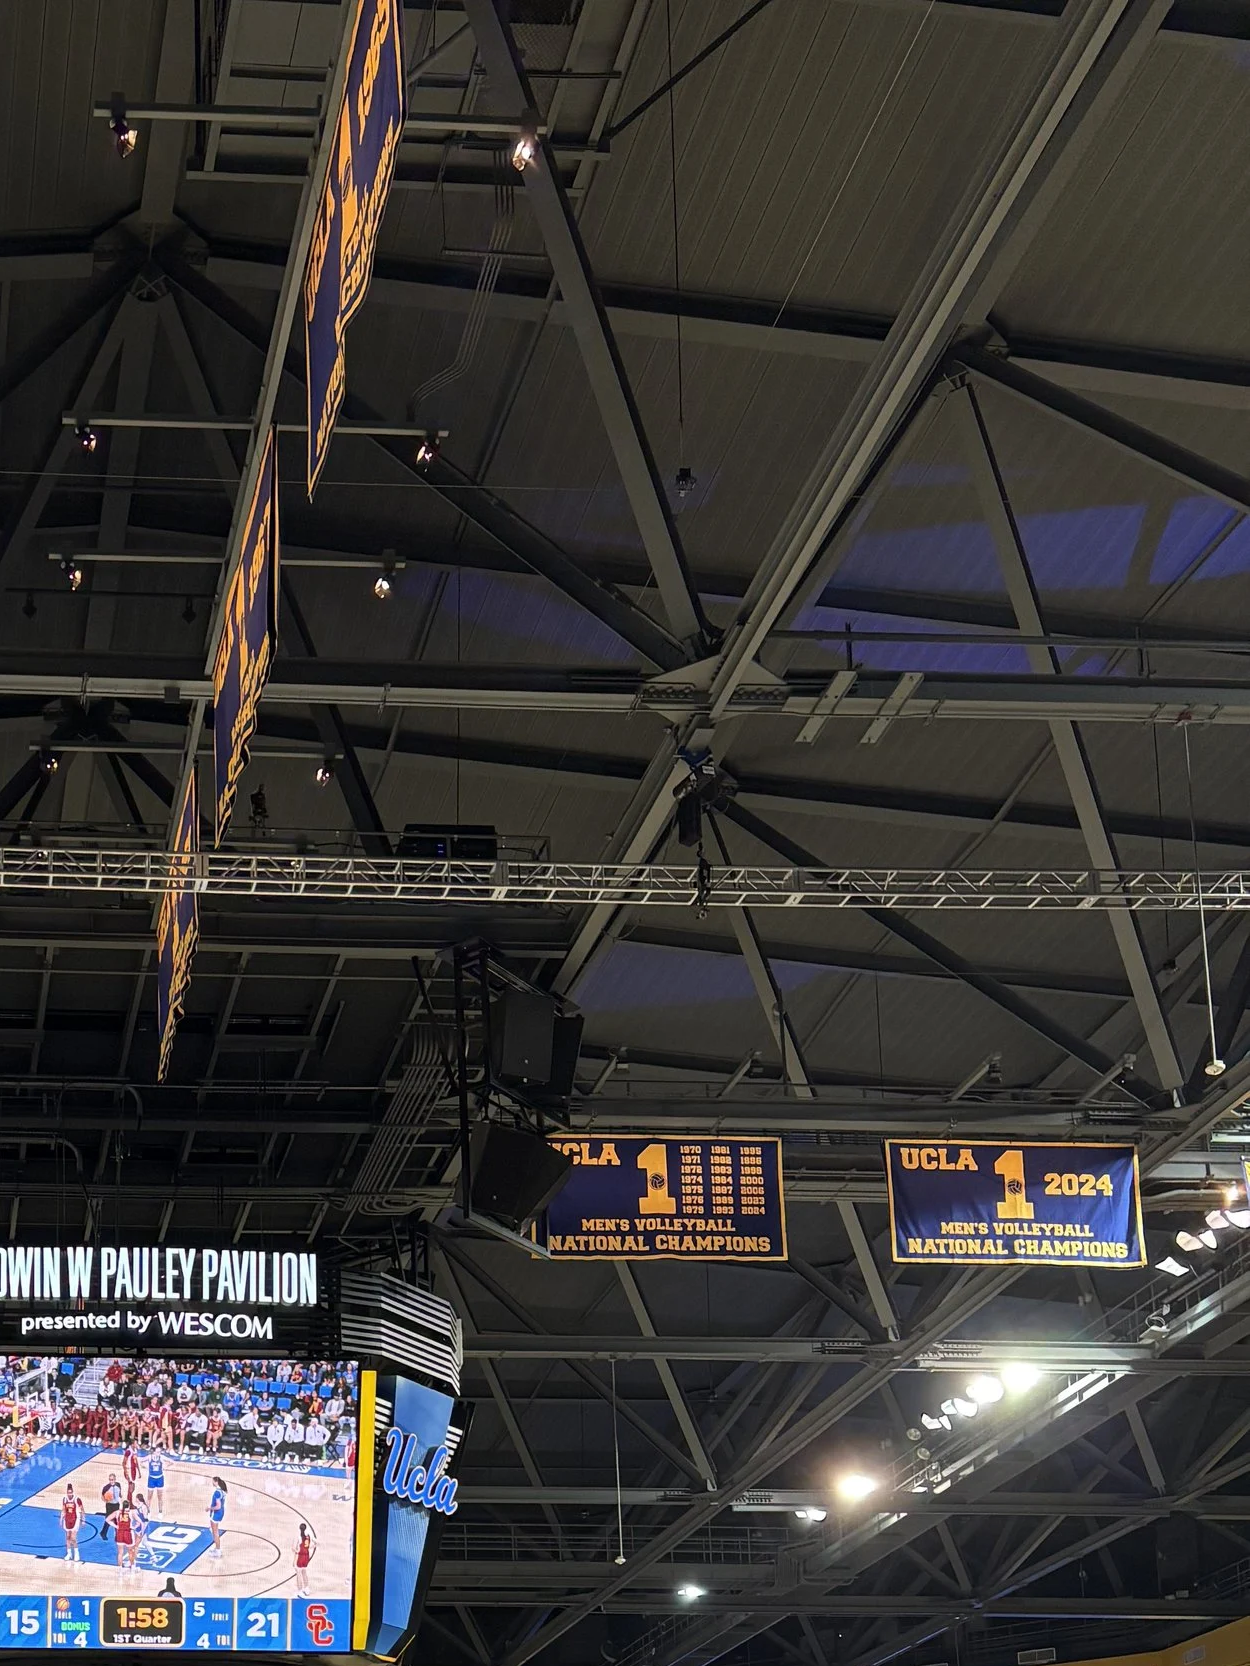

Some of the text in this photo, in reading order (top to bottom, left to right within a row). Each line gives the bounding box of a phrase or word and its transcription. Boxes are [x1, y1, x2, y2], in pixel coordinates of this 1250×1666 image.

[680, 1145, 702, 1154] 1970
[681, 1155, 701, 1164] 1971
[900, 1148, 978, 1171] UCLA
[681, 1165, 703, 1174] 1972
[637, 1143, 676, 1215] 1
[681, 1175, 703, 1184] 1974
[740, 1176, 764, 1185] 2000
[993, 1150, 1035, 1219] 1
[1044, 1173, 1113, 1197] 2024
[681, 1185, 704, 1194] 1975
[682, 1195, 704, 1204] 1976
[682, 1205, 705, 1214] 1979
[581, 1218, 736, 1232] MEN'S VOLLEYBALL
[941, 1222, 1094, 1238] MEN'S VOLLEYBALL
[549, 1234, 771, 1252] NATIONAL CHAMPIONS
[907, 1238, 1129, 1259] NATIONAL CHAMPIONS
[67, 1246, 93, 1299] W
[101, 1247, 197, 1300] PAULEY
[203, 1249, 318, 1305] PAVILION
[21, 1311, 274, 1340] presented by WESCOM
[383, 1427, 459, 1516] Ucla
[81, 1600, 91, 1616] 1
[193, 1601, 206, 1617] 5
[6, 1610, 40, 1635] 15
[116, 1607, 169, 1628] 1:58
[246, 1612, 280, 1638] 21
[61, 1622, 91, 1631] BONUS
[73, 1632, 88, 1648] 4
[113, 1634, 172, 1643] 1ST Quarter
[196, 1633, 210, 1649] 4
